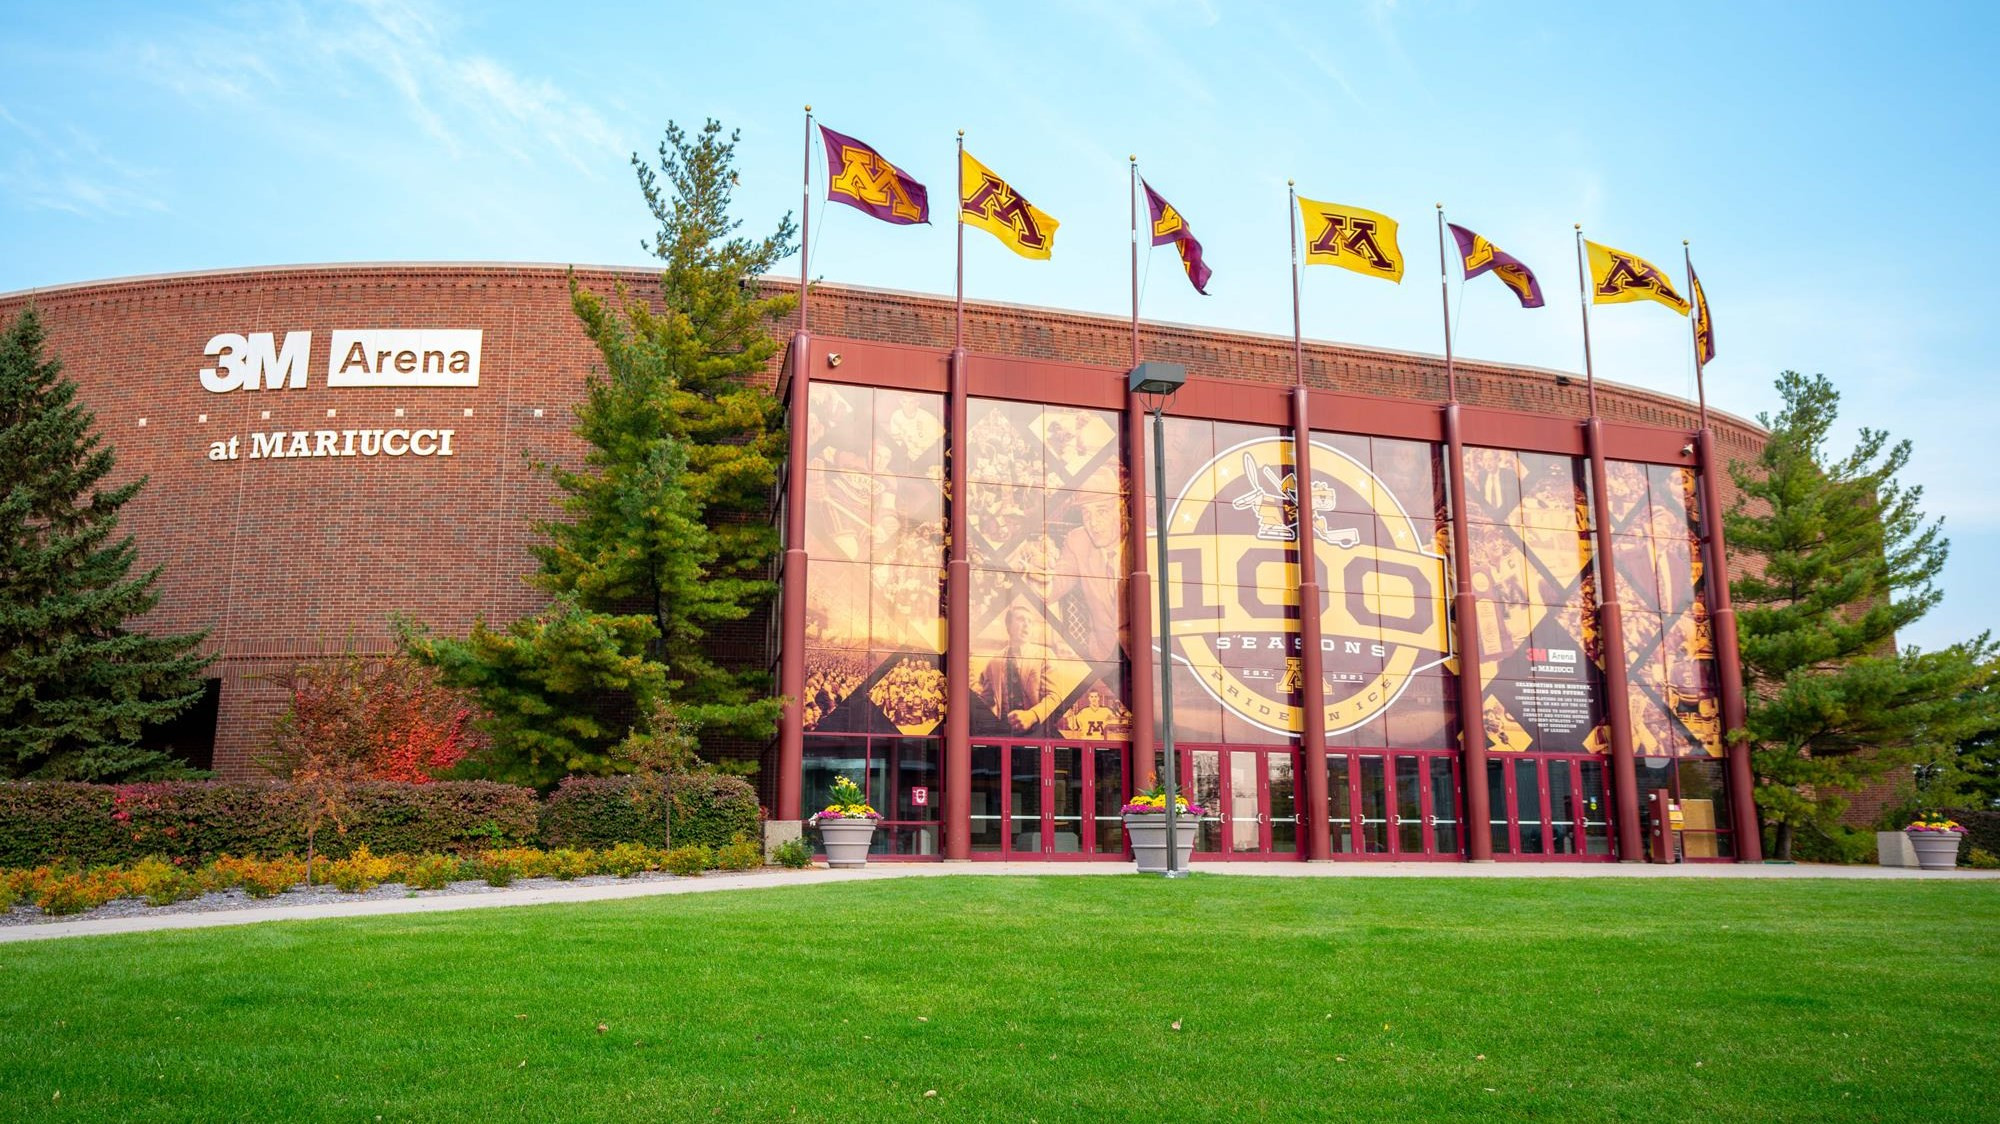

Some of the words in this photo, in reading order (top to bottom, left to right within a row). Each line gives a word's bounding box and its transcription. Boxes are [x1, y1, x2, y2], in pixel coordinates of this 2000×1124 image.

[200, 331, 313, 393] 3M
[339, 341, 471, 375] Arena
[208, 436, 240, 462] at
[249, 428, 456, 460] MARIUCCI
[1166, 547, 1434, 635] 100
[1243, 669, 1275, 678] EST.
[1526, 647, 1547, 662] 3M
[1211, 669, 1290, 722] PRIDE
[1356, 679, 1392, 711] ICE
